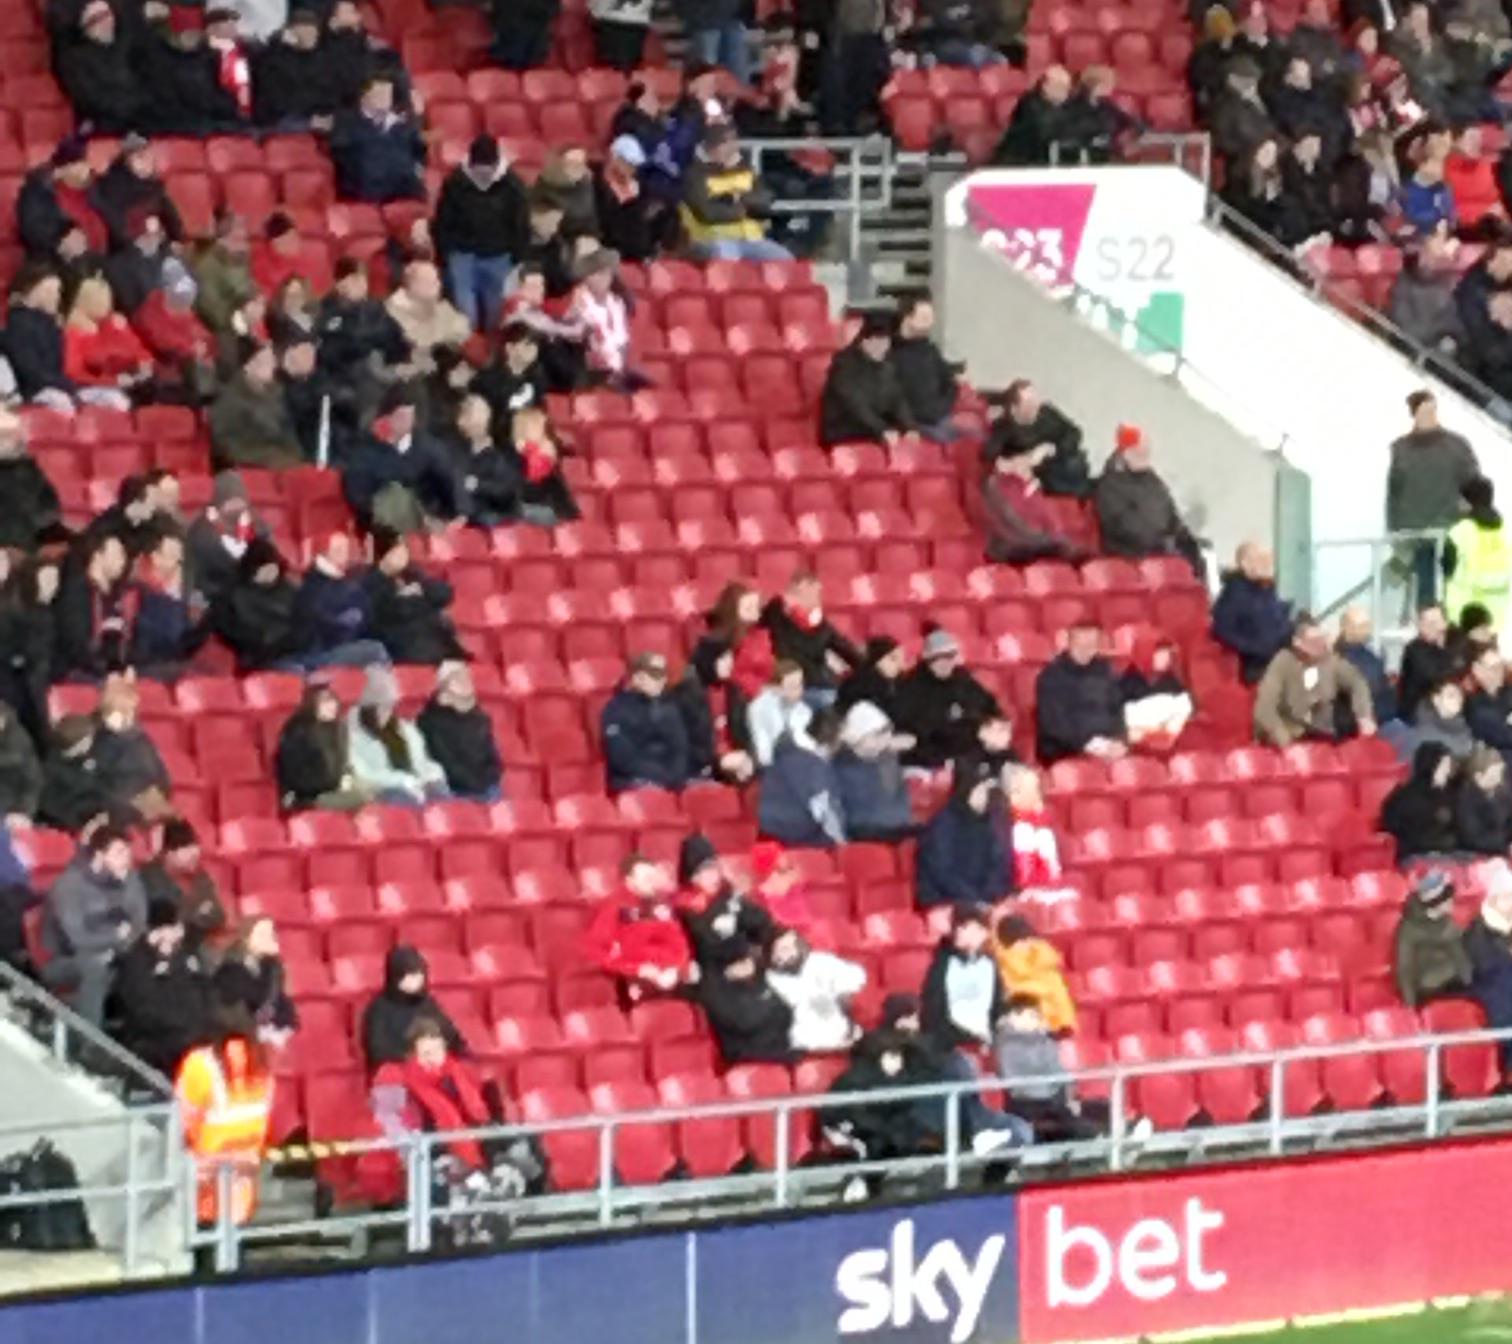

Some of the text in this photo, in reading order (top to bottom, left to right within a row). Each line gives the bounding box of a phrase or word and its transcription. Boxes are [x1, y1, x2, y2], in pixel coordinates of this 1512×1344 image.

[1096, 233, 1176, 282] S22
[836, 1197, 1228, 1344] sky bet
